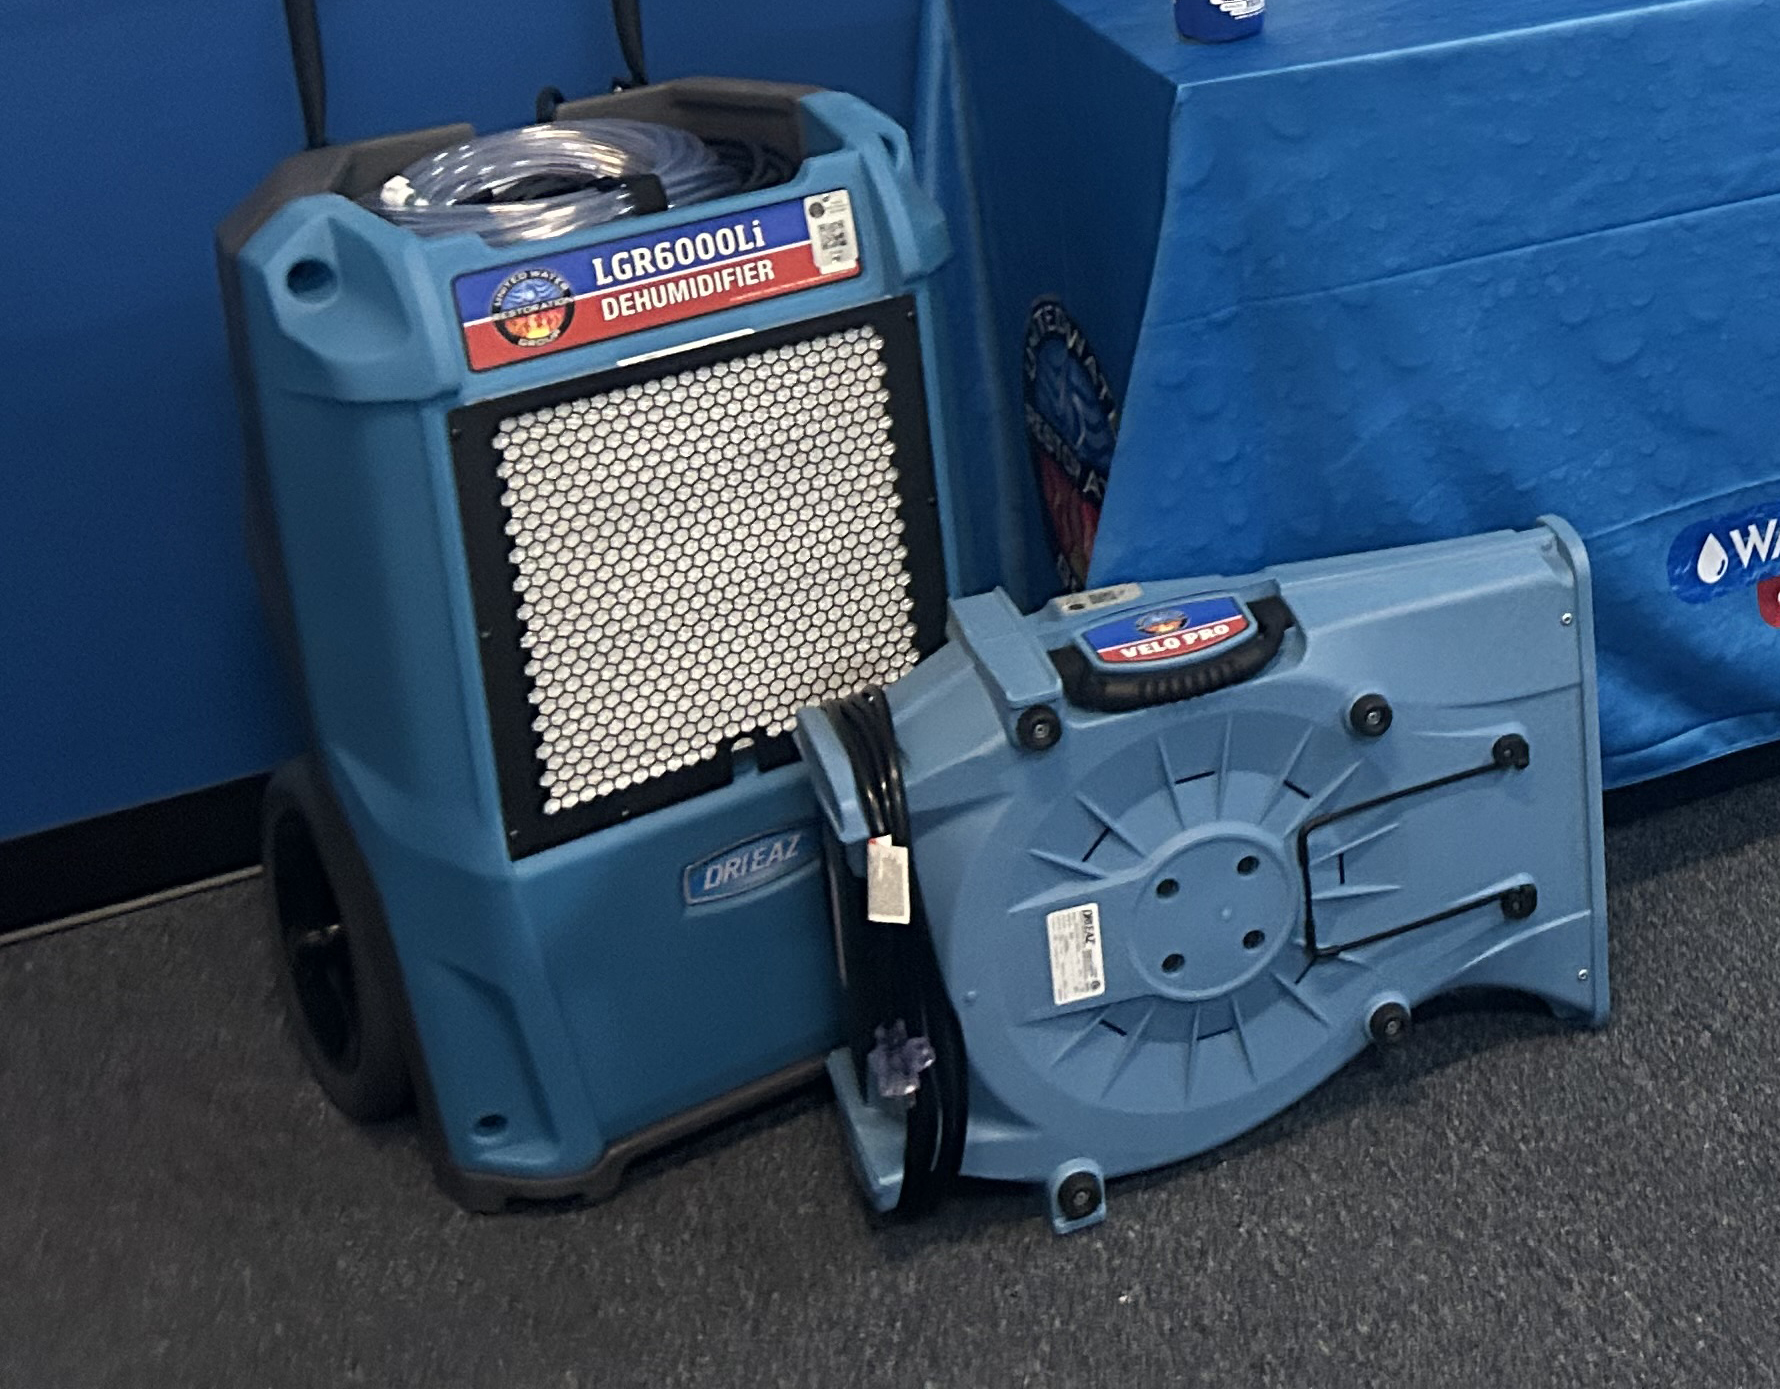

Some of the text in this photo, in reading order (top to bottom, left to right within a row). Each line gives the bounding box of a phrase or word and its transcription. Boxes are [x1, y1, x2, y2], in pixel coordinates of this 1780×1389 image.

[593, 219, 766, 286] LGR6000Li
[601, 259, 775, 322] DEHUMIDIFIER
[1119, 624, 1230, 658] VELO PRO
